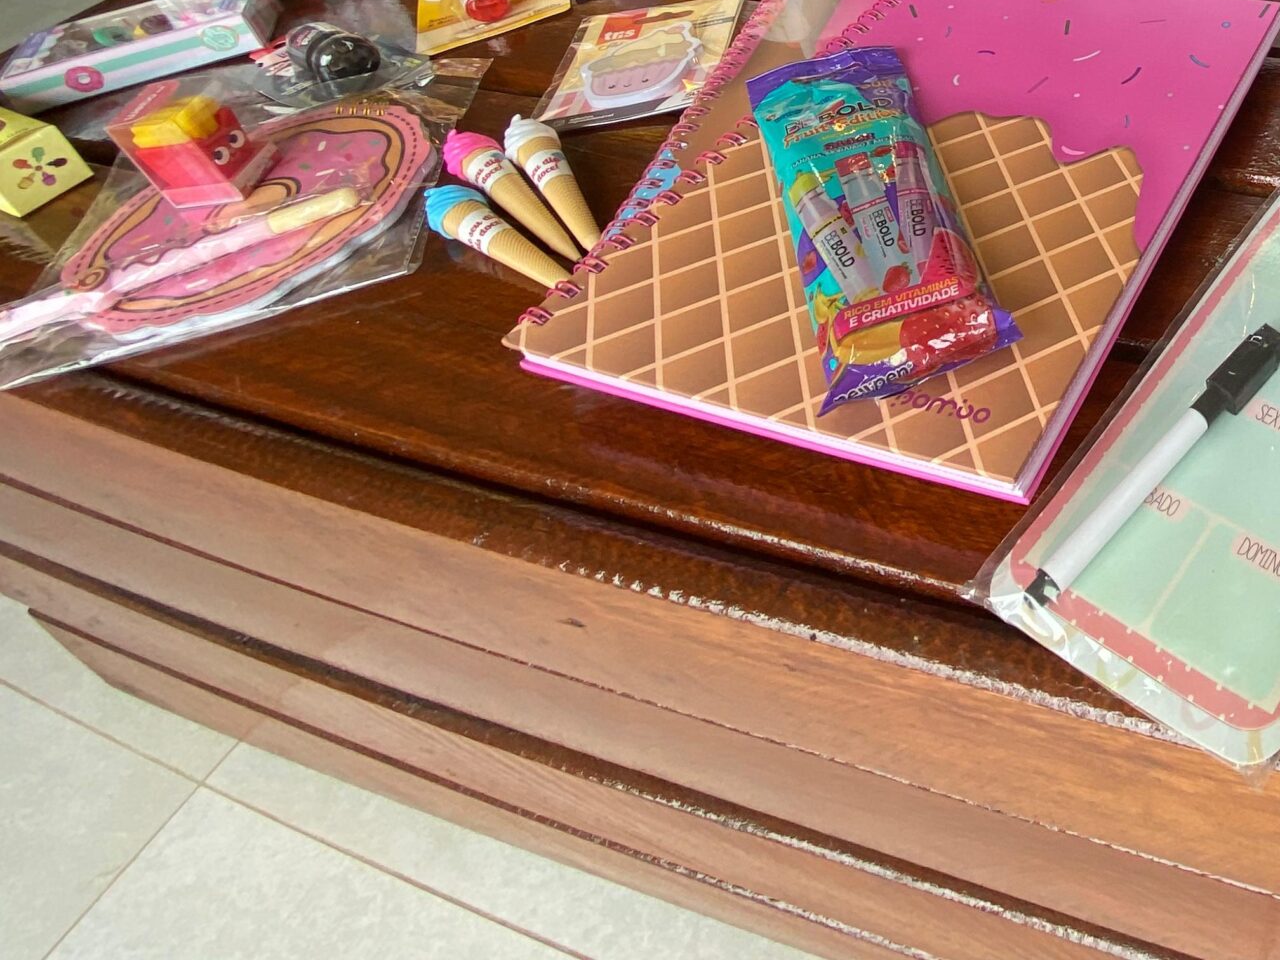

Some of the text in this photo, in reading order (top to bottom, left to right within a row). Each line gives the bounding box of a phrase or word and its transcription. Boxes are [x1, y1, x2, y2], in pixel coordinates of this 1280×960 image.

[844, 276, 959, 320] RICO EM VITAMINAS
[849, 284, 960, 328] E CRIATIVIDADE
[1144, 487, 1181, 517] BADO
